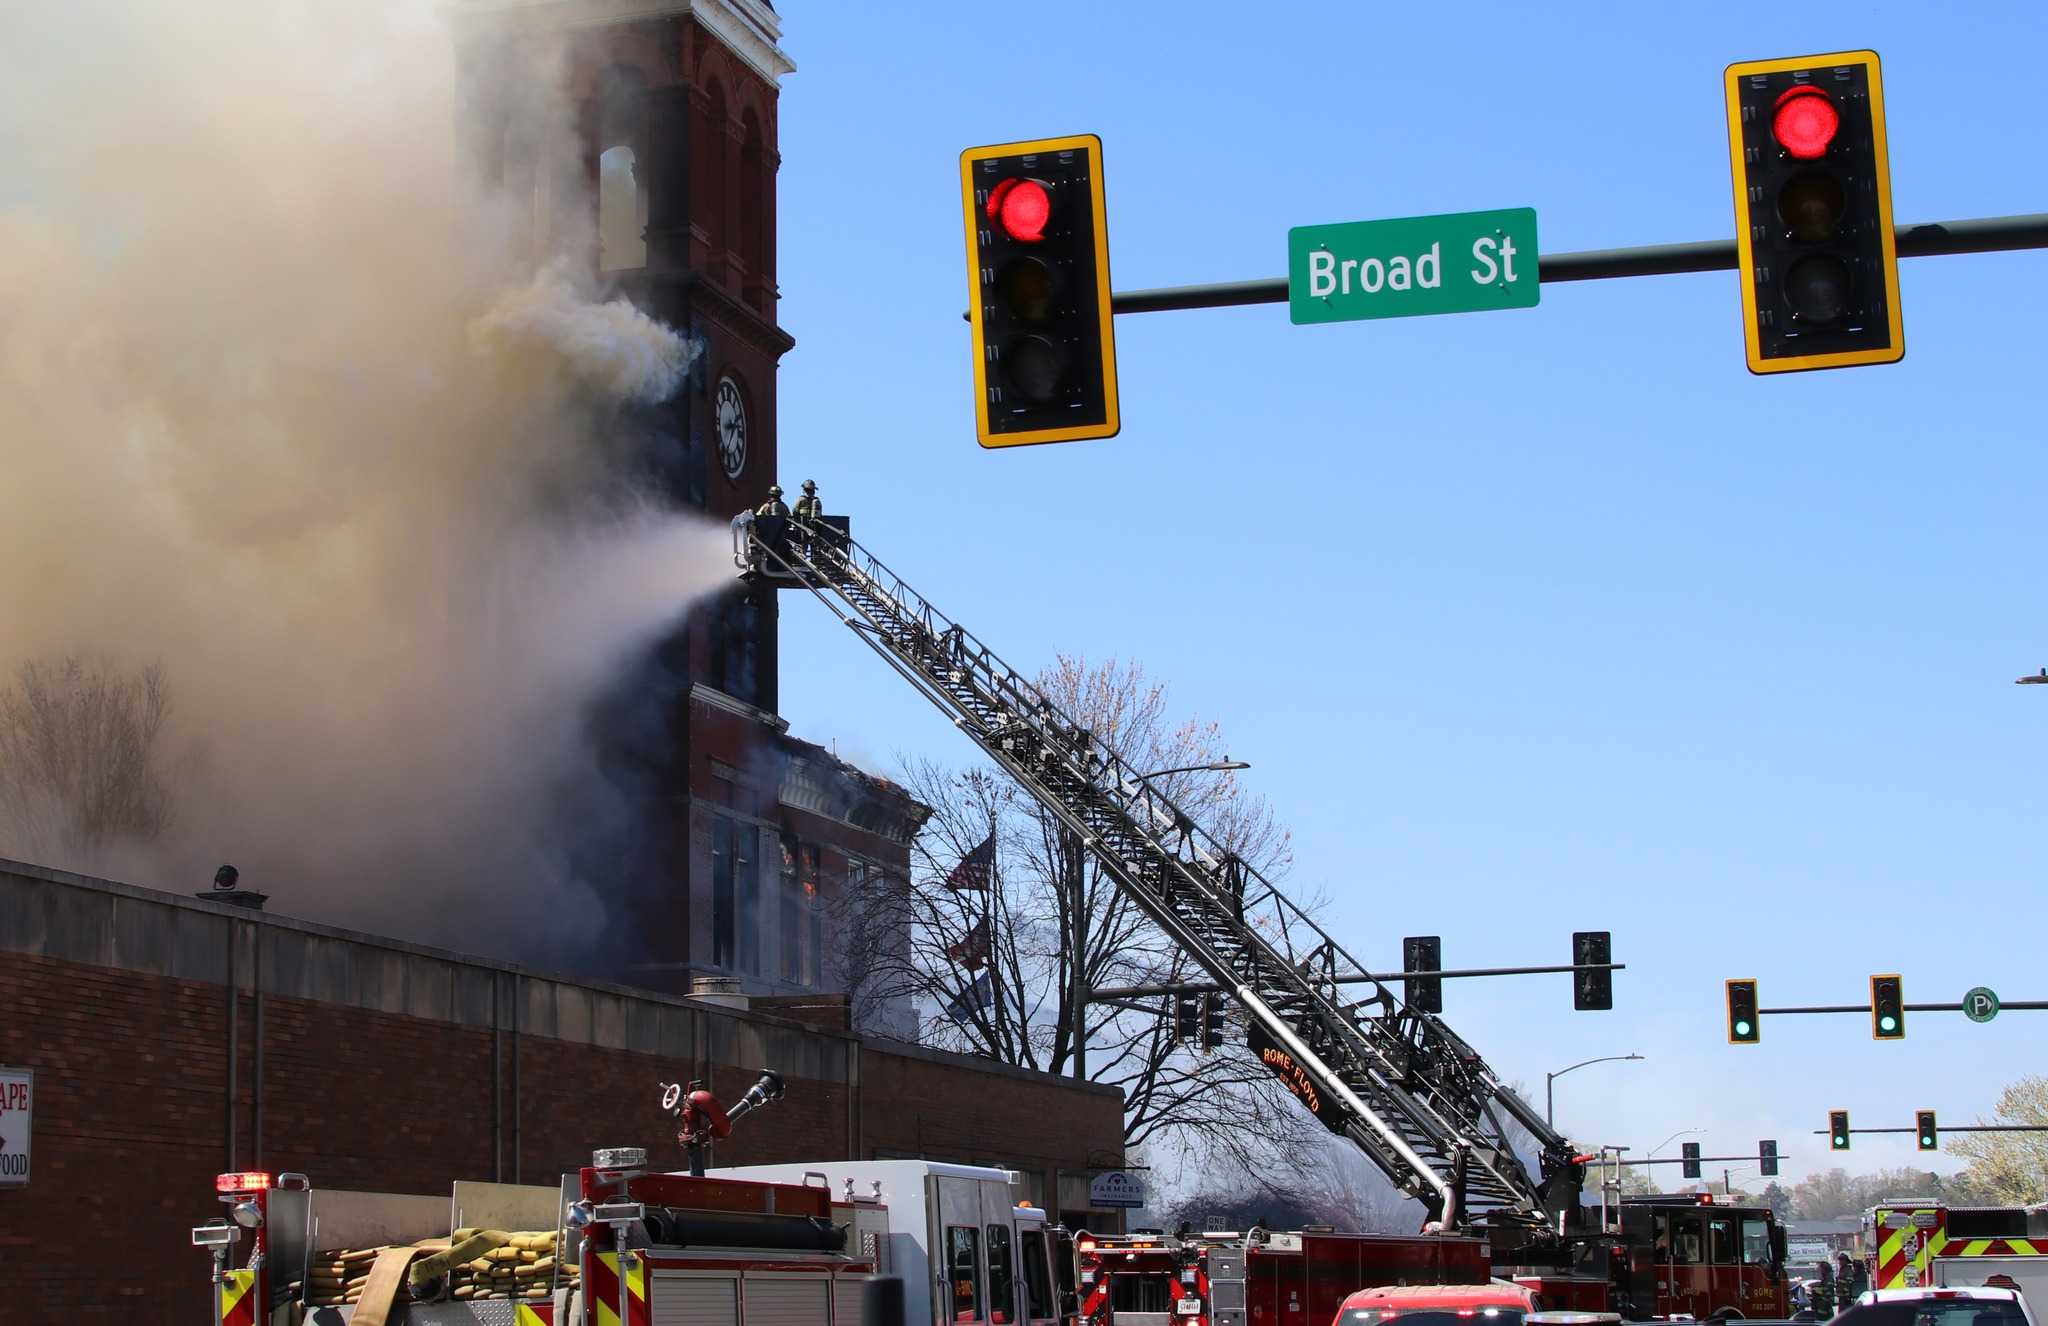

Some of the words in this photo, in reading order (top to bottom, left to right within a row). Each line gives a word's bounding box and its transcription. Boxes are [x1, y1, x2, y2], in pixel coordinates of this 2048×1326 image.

[1309, 242, 1441, 297] Broad
[1471, 236, 1518, 285] St
[0, 1153, 27, 1175] OOD
[1094, 1184, 1140, 1193] FARMERS
[1208, 1216, 1225, 1225] ONE
[1208, 1224, 1225, 1232] WAY
[1753, 1287, 1773, 1298] ROME
